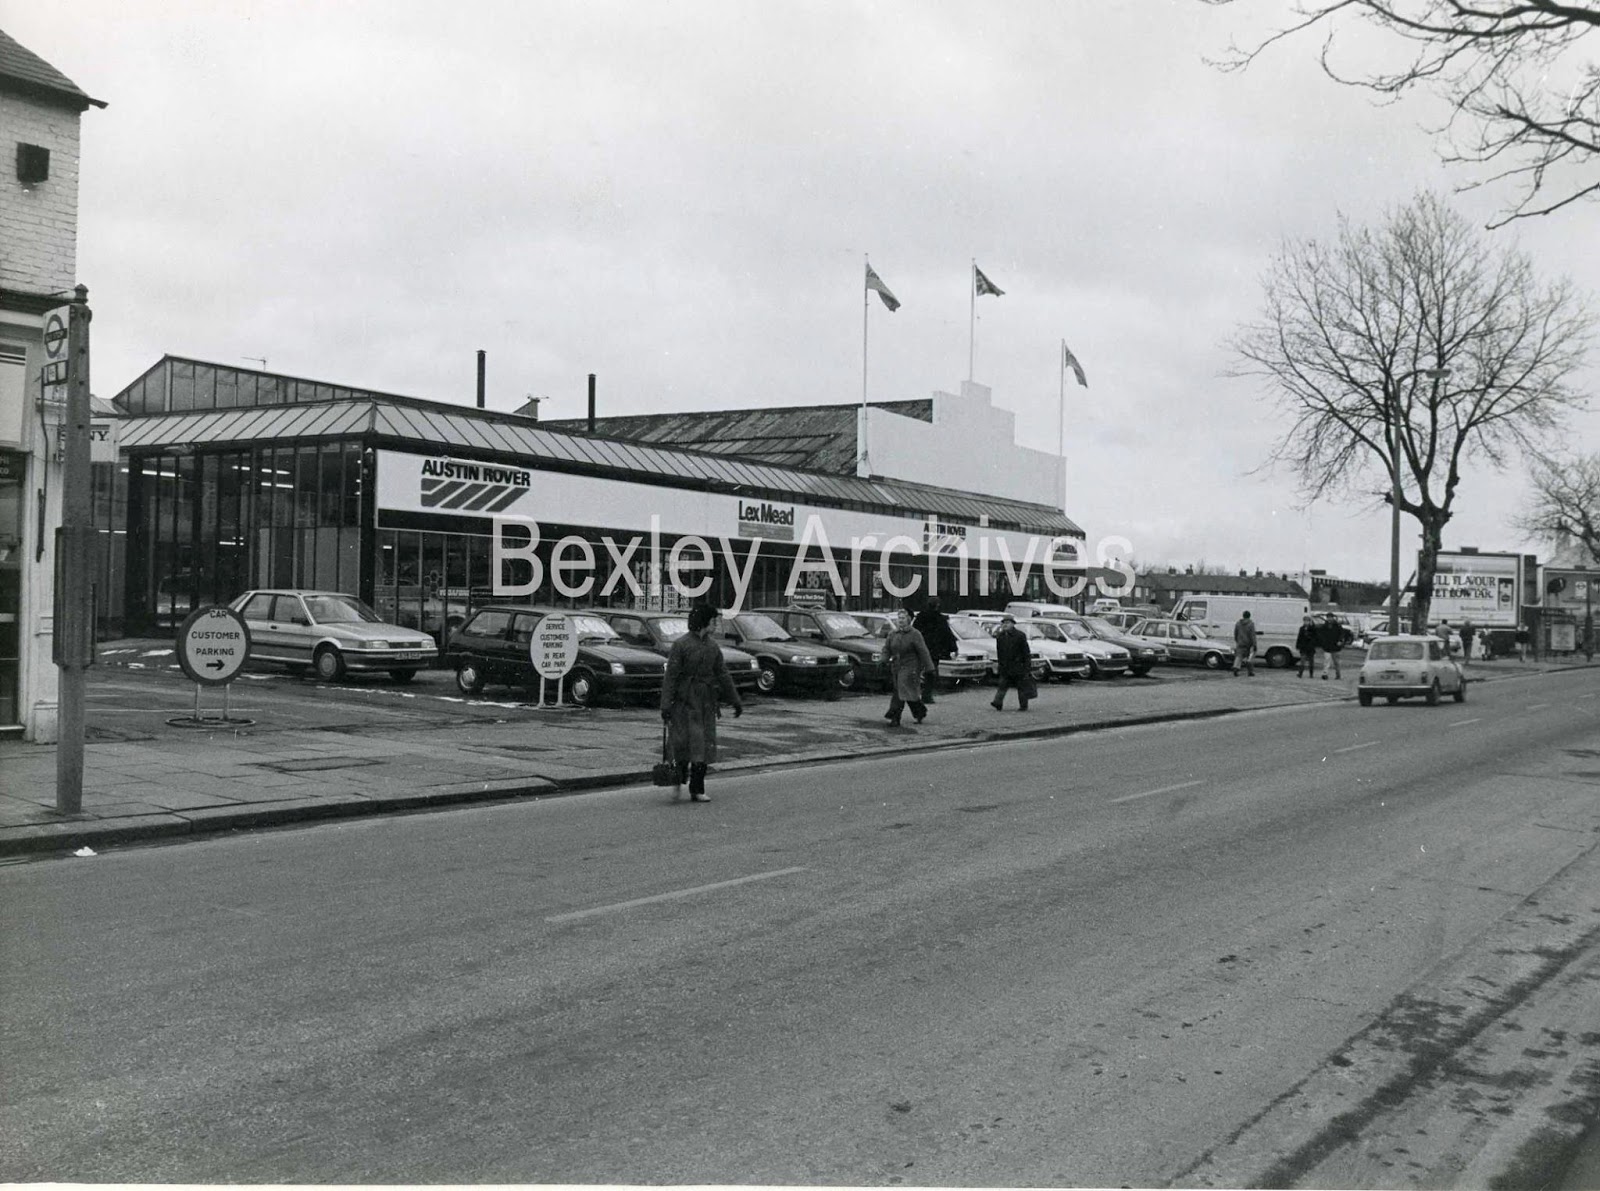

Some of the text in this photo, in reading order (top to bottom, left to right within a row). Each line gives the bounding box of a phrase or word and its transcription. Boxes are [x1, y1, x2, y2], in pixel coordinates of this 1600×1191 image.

[421, 459, 531, 487] AUSTIN ROVER
[738, 500, 794, 526] Lex Mead
[923, 522, 946, 534] ATIN
[1452, 575, 1496, 587] FLAVOUR
[210, 609, 227, 619] CAR
[191, 631, 240, 640] CUSTOMER
[540, 633, 570, 641] CUSTOMERS
[196, 648, 235, 656] PARKING
[544, 652, 550, 660] IN
